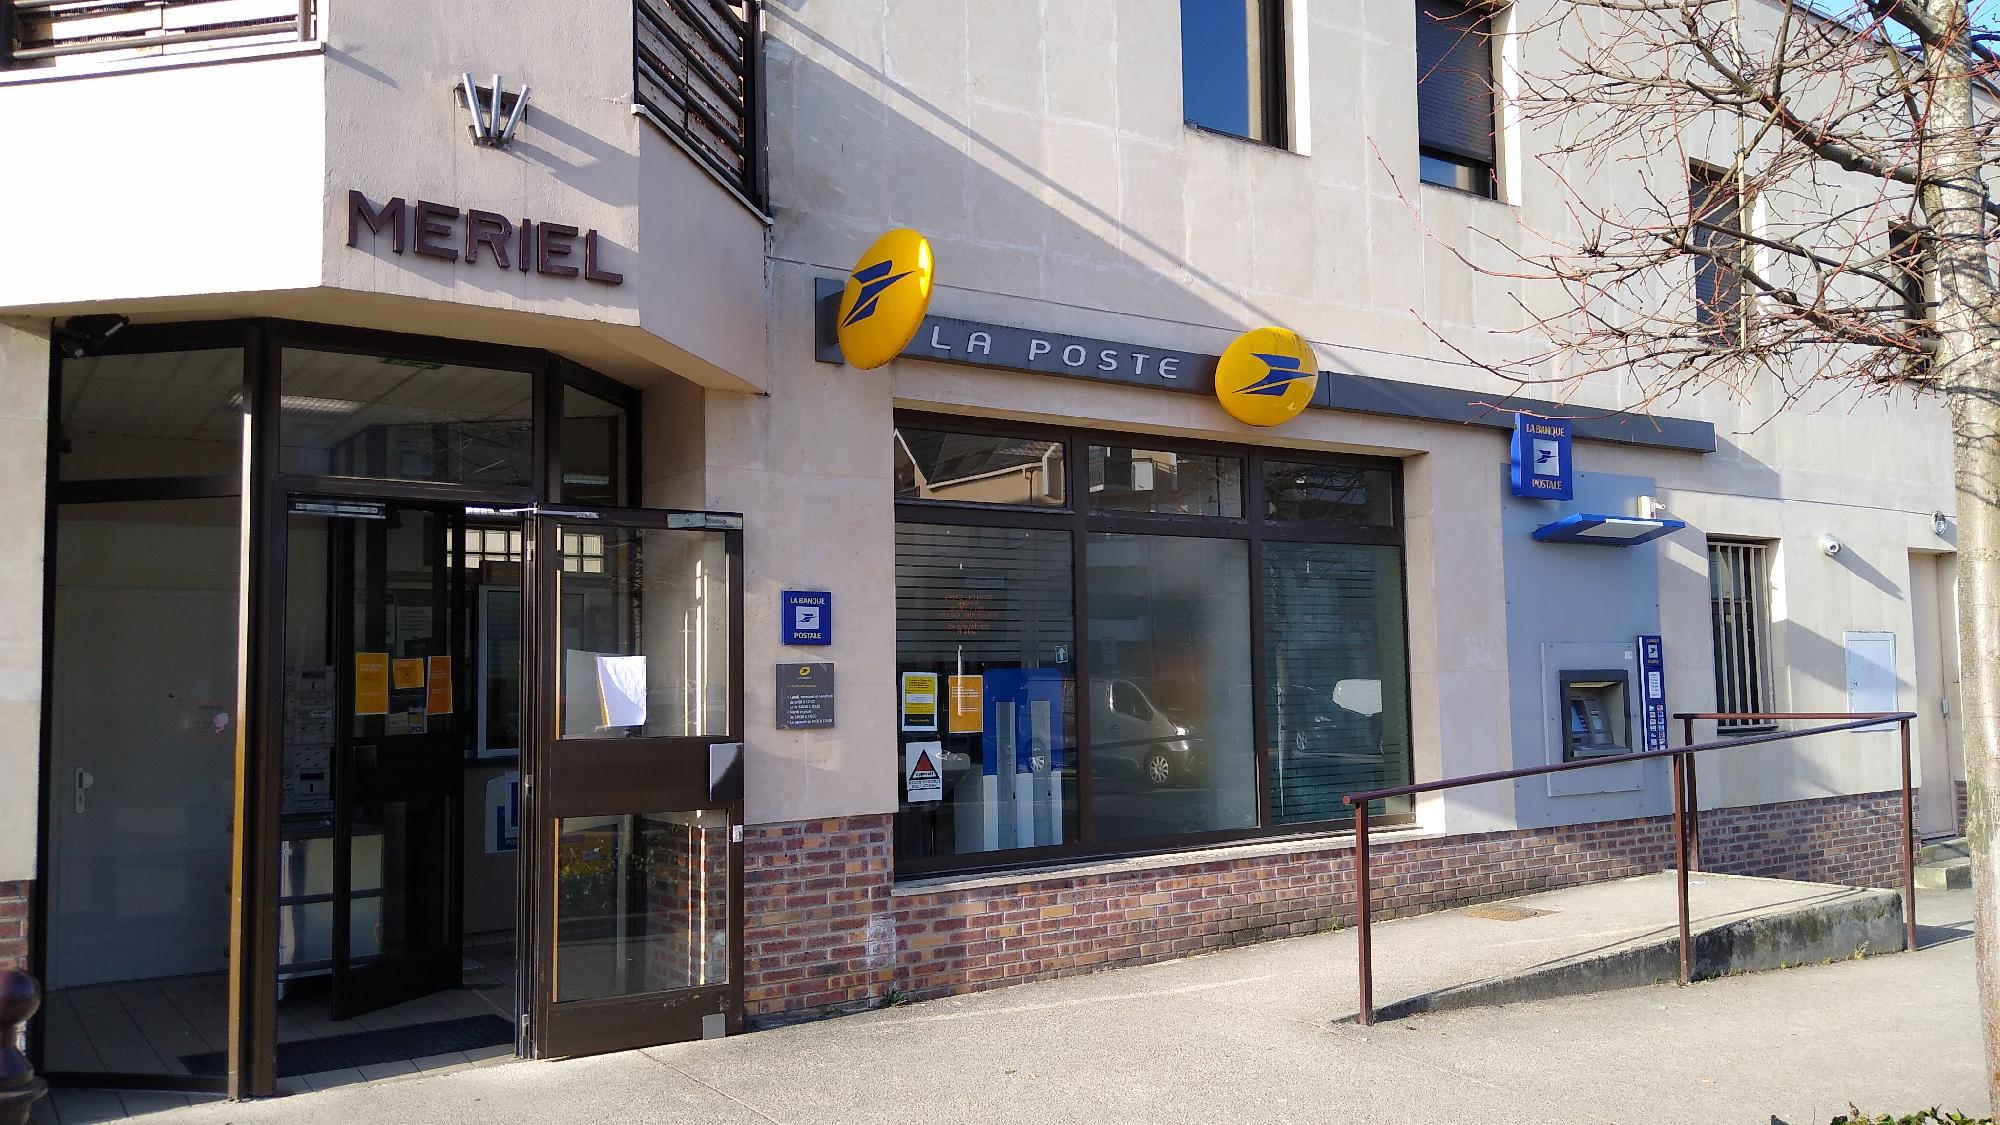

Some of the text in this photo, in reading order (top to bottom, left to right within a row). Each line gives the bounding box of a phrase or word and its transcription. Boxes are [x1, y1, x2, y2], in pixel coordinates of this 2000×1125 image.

[346, 189, 624, 285] MERIEL
[930, 325, 1181, 379] LA POSTE
[1526, 423, 1565, 438] LA BANQUE
[1531, 478, 1562, 490] POSTALE
[790, 596, 826, 605] LA BANQUE
